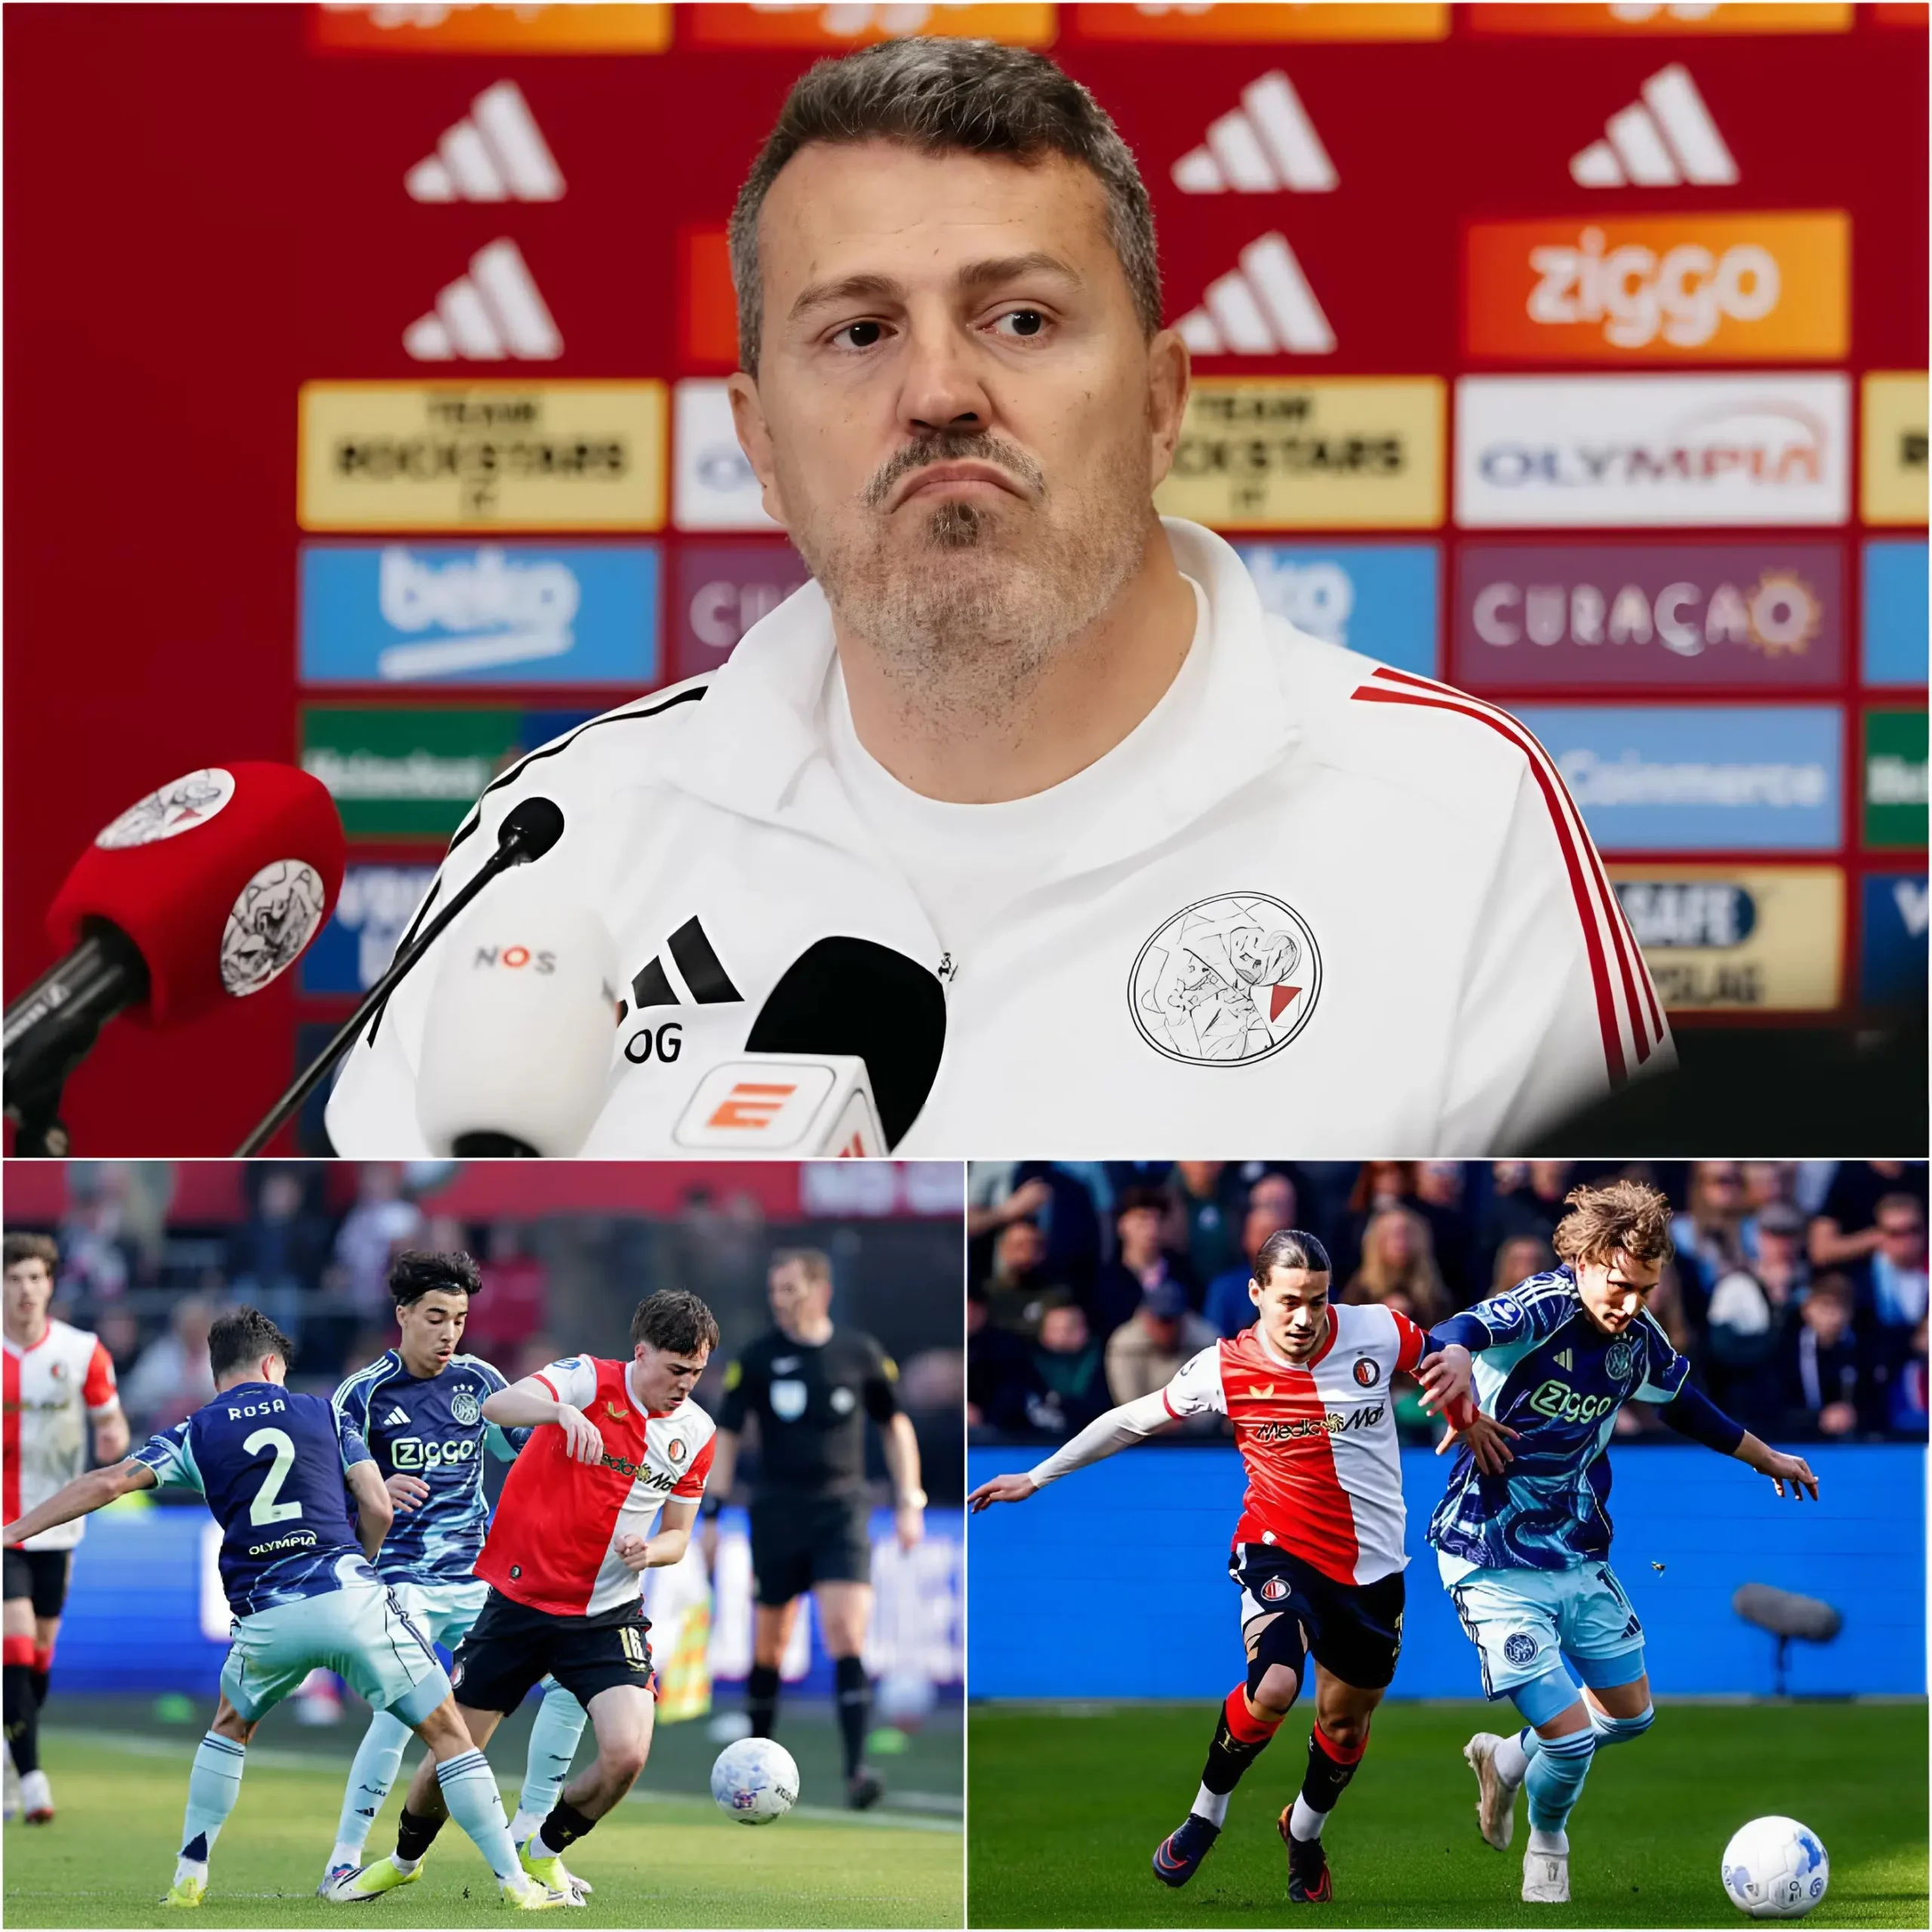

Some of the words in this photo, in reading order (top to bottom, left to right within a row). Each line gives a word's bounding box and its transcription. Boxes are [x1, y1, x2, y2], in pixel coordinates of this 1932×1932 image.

[1526, 226, 1781, 347] ziggo
[1174, 438, 1404, 478] CKSTARS
[1479, 444, 1826, 488] OLYMPIA
[380, 542, 580, 632] beko
[1247, 545, 1357, 632] ko
[1473, 581, 1814, 657] CURAÇAO
[472, 946, 557, 976] NOS
[623, 1022, 683, 1064] OG
[228, 1399, 285, 1421] ROSA
[242, 1427, 303, 1527] 2
[248, 1534, 317, 1555] OLYMPIA
